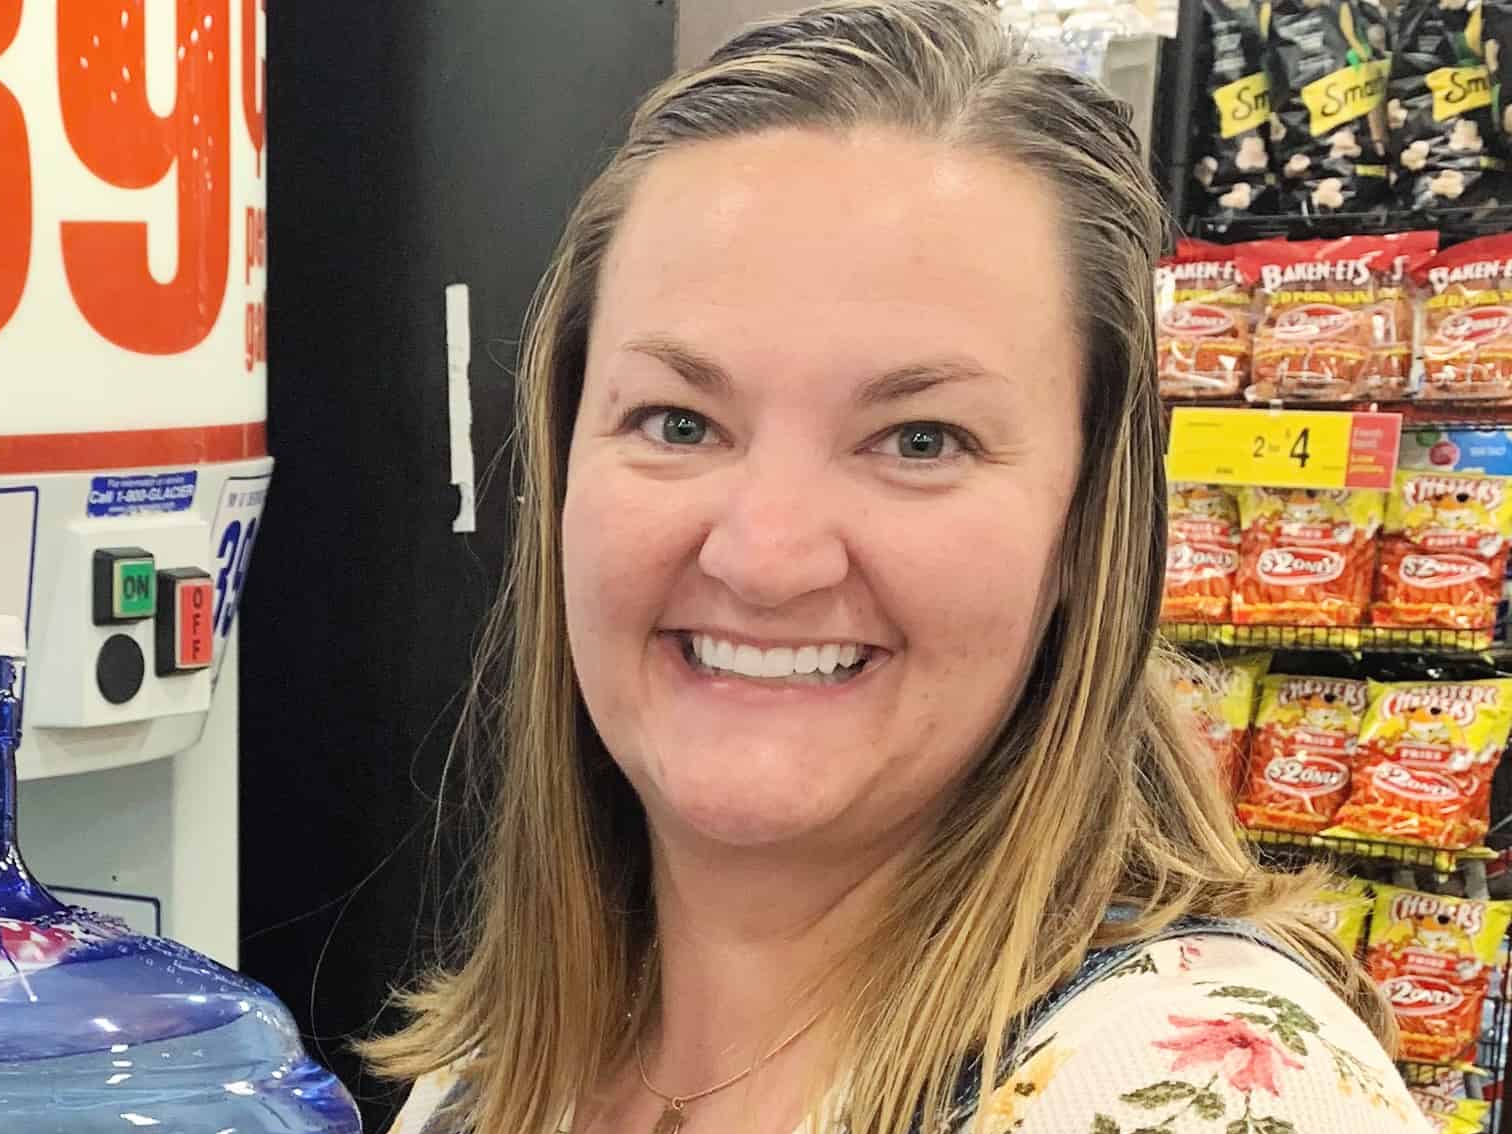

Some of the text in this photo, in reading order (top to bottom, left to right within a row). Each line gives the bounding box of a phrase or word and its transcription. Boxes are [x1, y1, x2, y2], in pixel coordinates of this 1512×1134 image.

[1253, 436, 1265, 458] 2
[123, 575, 149, 600] ON
[192, 586, 204, 660] OFF
